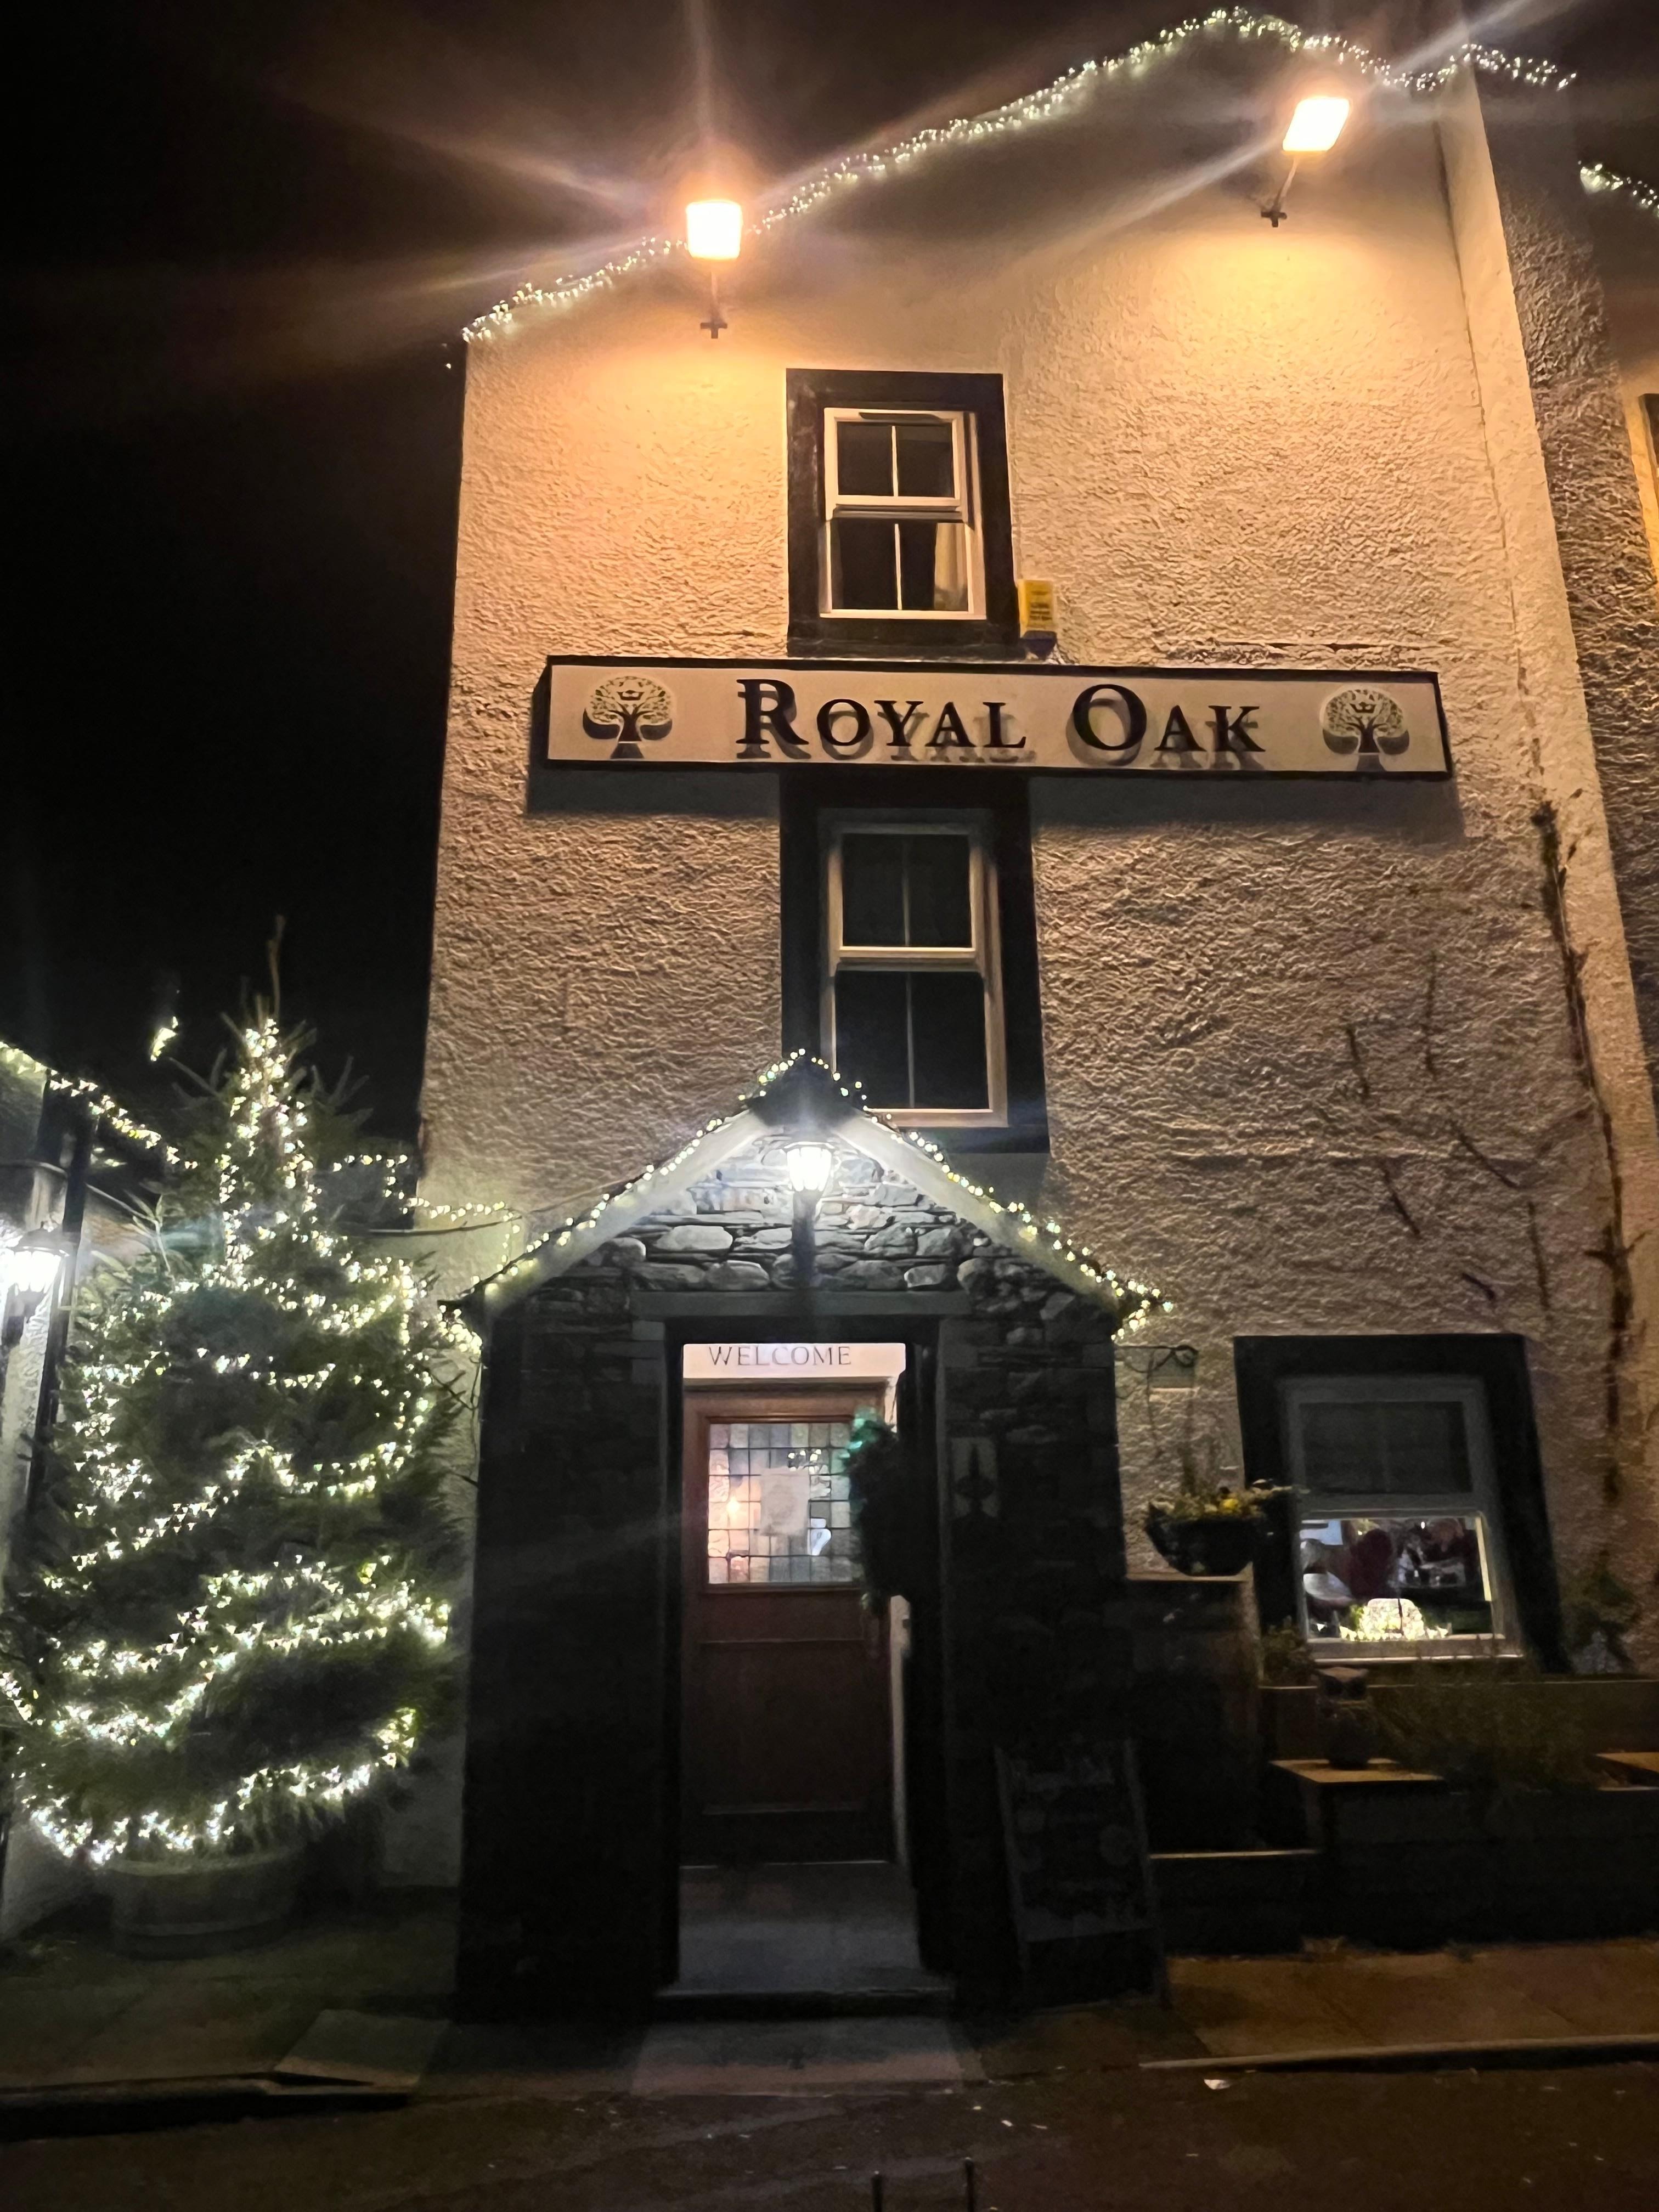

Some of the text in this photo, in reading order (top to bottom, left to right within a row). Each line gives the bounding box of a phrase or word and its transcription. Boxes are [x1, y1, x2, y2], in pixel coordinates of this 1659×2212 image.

[736, 679, 1266, 752] ROYAL OAK
[709, 1346, 851, 1365] WELCOME
